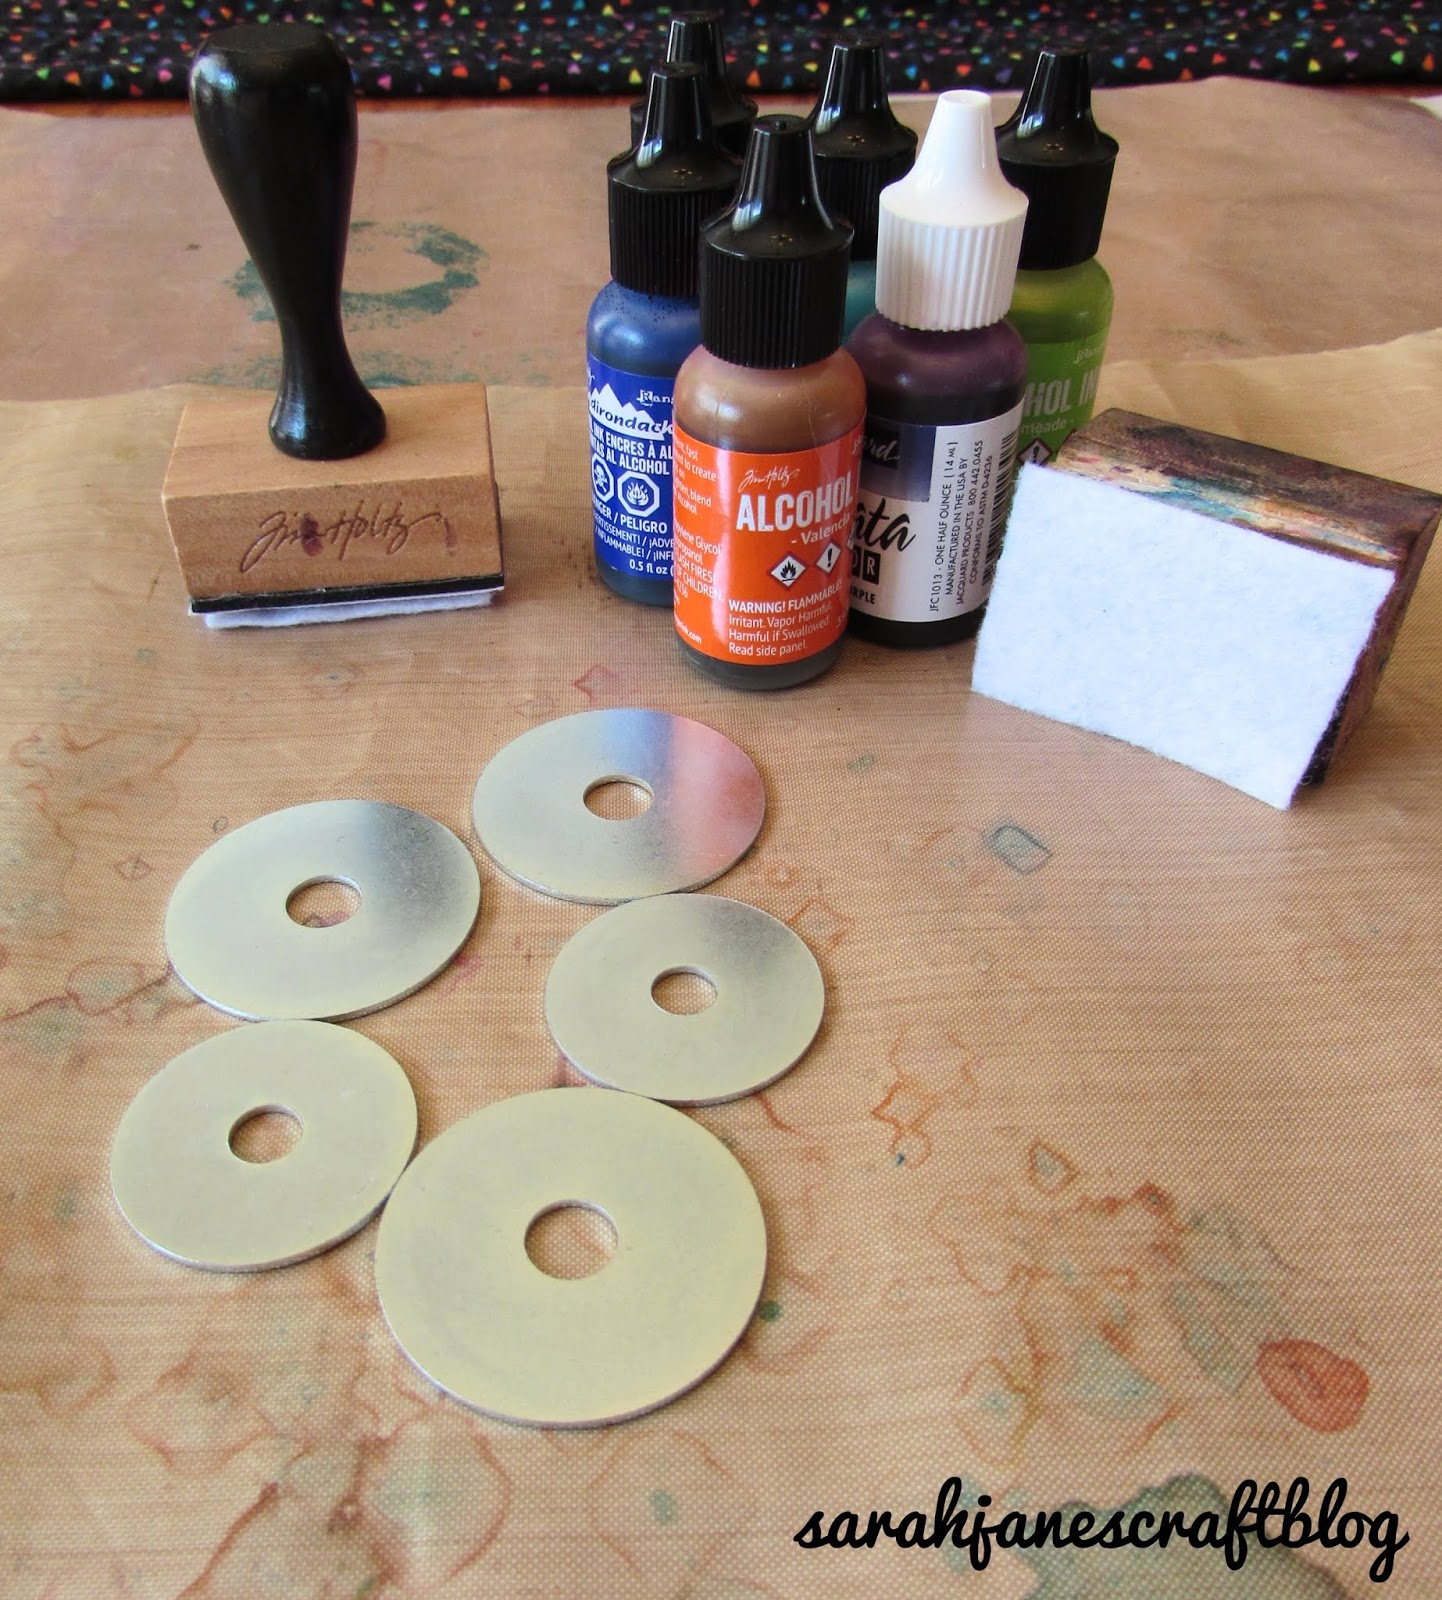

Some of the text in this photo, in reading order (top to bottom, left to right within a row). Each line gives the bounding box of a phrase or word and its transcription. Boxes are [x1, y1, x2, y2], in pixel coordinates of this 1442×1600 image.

[636, 389, 674, 407] Ran
[605, 431, 645, 457] ENCRES
[647, 440, 657, 459] À
[606, 448, 617, 466] AL
[619, 453, 670, 476] ALCOHOL
[691, 464, 717, 482] create
[690, 488, 712, 508] blend
[736, 470, 854, 532] ALCOHOL
[939, 483, 952, 519] OUNCE
[978, 489, 988, 515] ASTM
[620, 513, 668, 535] PELIGRO
[800, 512, 851, 546] Valencia
[937, 521, 948, 543] HALF
[945, 457, 968, 595] MANUFACTURED IN THE USA BY
[976, 517, 985, 531] TO
[695, 535, 721, 556] Glycol
[934, 545, 946, 566] ONE
[629, 558, 644, 573] 0.5
[646, 562, 654, 574] fl
[655, 565, 668, 576] oz
[955, 559, 969, 605] JACQUARD
[962, 510, 975, 558] PRODUCTS
[728, 599, 786, 614] WARNING!
[729, 613, 766, 629] Irritant.
[767, 616, 797, 629] Vapor
[729, 628, 770, 643] Harmful
[772, 628, 780, 641] if
[729, 639, 808, 657] Read side panel.
